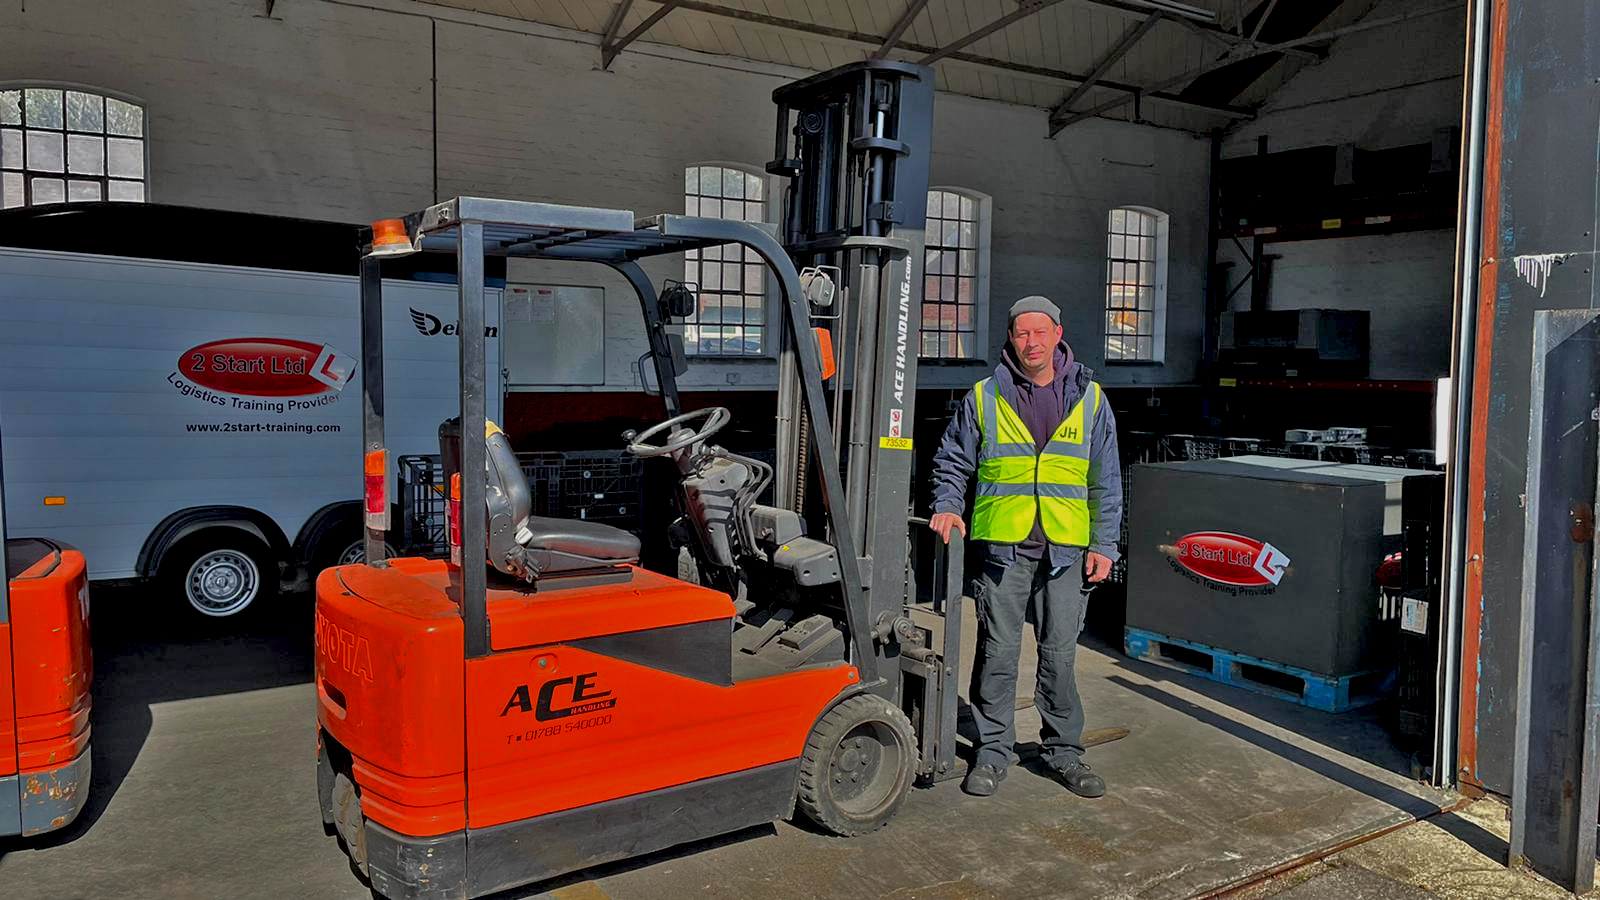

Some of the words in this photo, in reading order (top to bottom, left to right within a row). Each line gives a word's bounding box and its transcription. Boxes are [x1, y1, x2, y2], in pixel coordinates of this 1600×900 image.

[409, 307, 498, 338] Deln
[895, 256, 912, 369] HANDLING.com
[191, 354, 205, 372] 2
[212, 353, 265, 373] Start
[271, 357, 305, 374] Ltd
[167, 371, 226, 406] Logistics
[231, 397, 284, 413] Training
[288, 393, 340, 411] Provider
[894, 370, 905, 404] ACE
[186, 422, 341, 434] www.2start-training.com
[1060, 426, 1077, 440] JH
[885, 438, 908, 448] 73532
[1179, 542, 1188, 557] 2
[1192, 543, 1225, 563] Start
[1228, 549, 1252, 567] Ltd
[315, 609, 374, 683] YOTA
[499, 671, 614, 722] ACE
[571, 701, 611, 714] HANDLING
[525, 725, 562, 741] 01788
[565, 715, 612, 733] 540000
